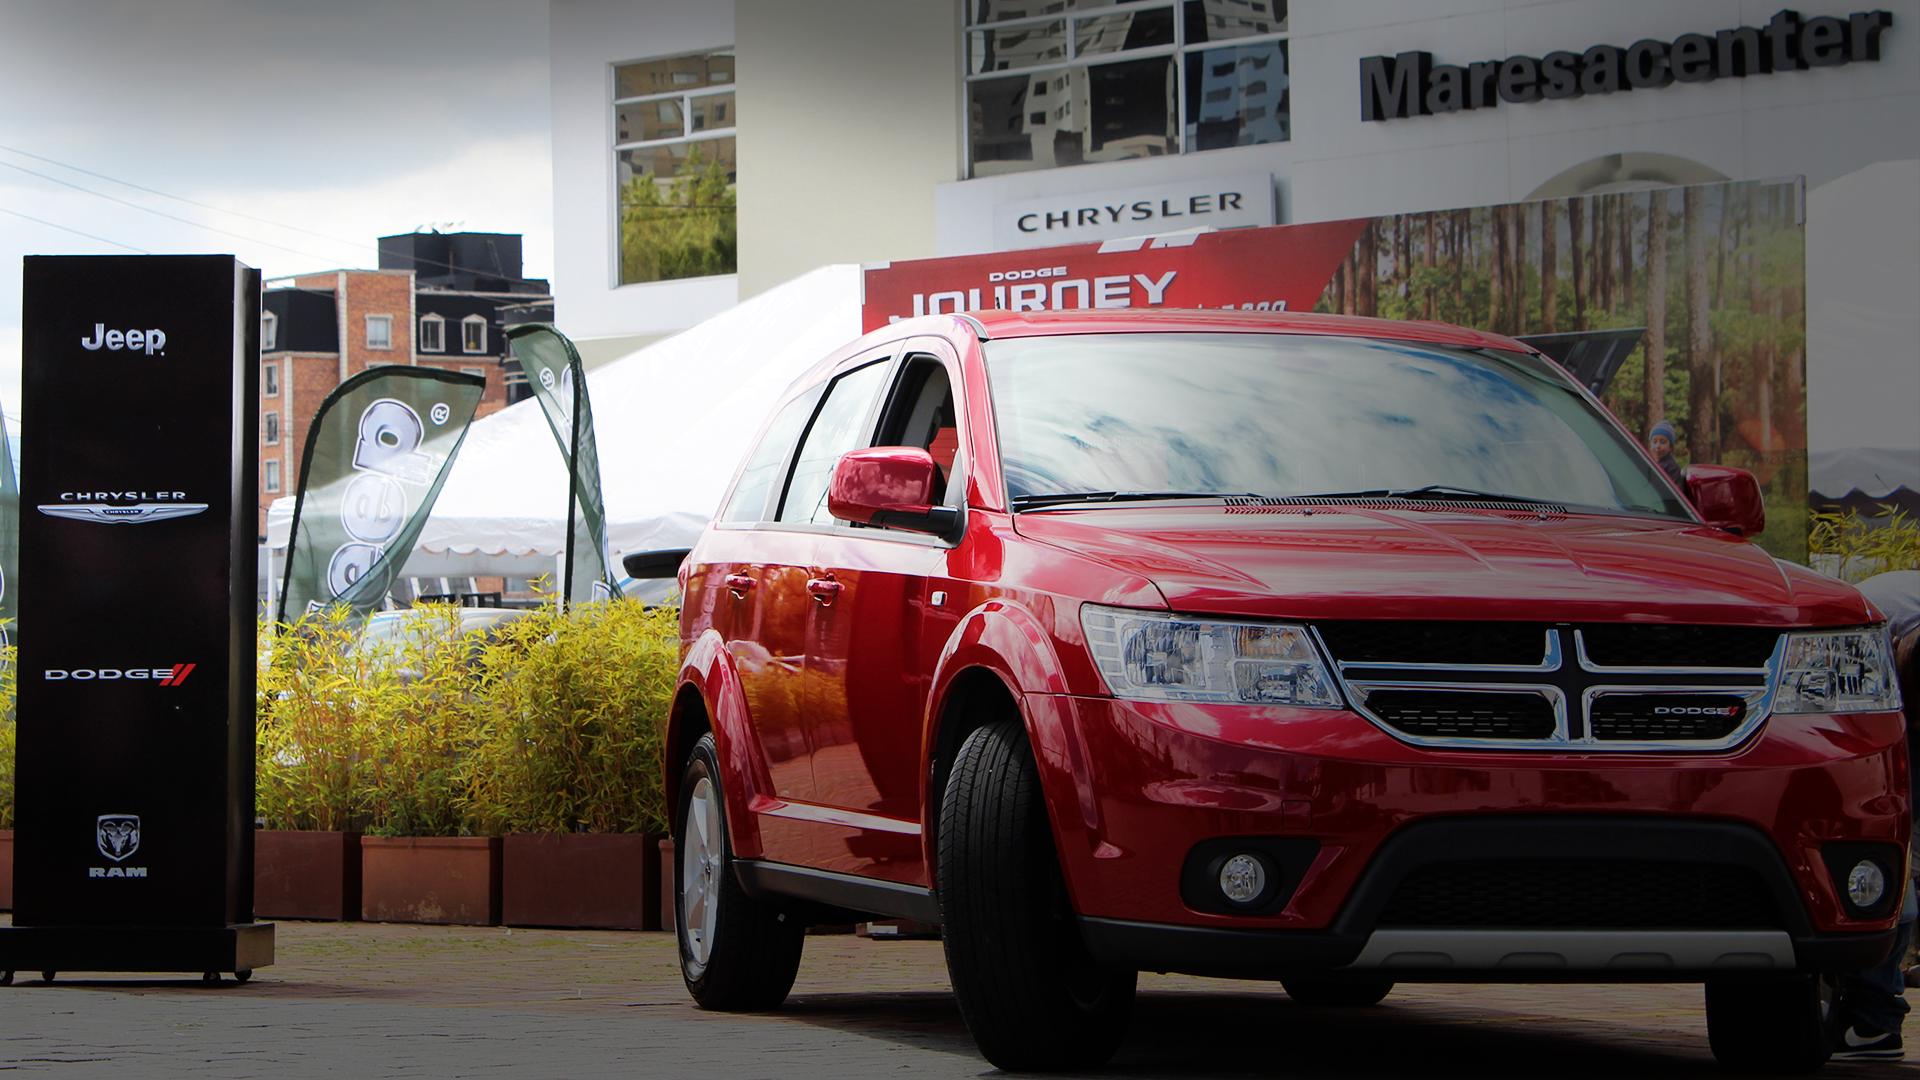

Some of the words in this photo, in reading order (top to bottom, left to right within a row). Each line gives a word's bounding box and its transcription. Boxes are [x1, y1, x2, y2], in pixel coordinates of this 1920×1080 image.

[1360, 9, 1893, 122] Maresacenter
[1017, 192, 1243, 233] CHRYSLER
[989, 266, 1068, 282] DODGE
[889, 271, 1177, 324] JOURNEY
[81, 323, 166, 356] Jeep
[60, 491, 186, 500] CHRYSLER
[45, 669, 174, 680] DODGE
[1654, 707, 1730, 715] DODGE
[89, 867, 147, 877] RAM
